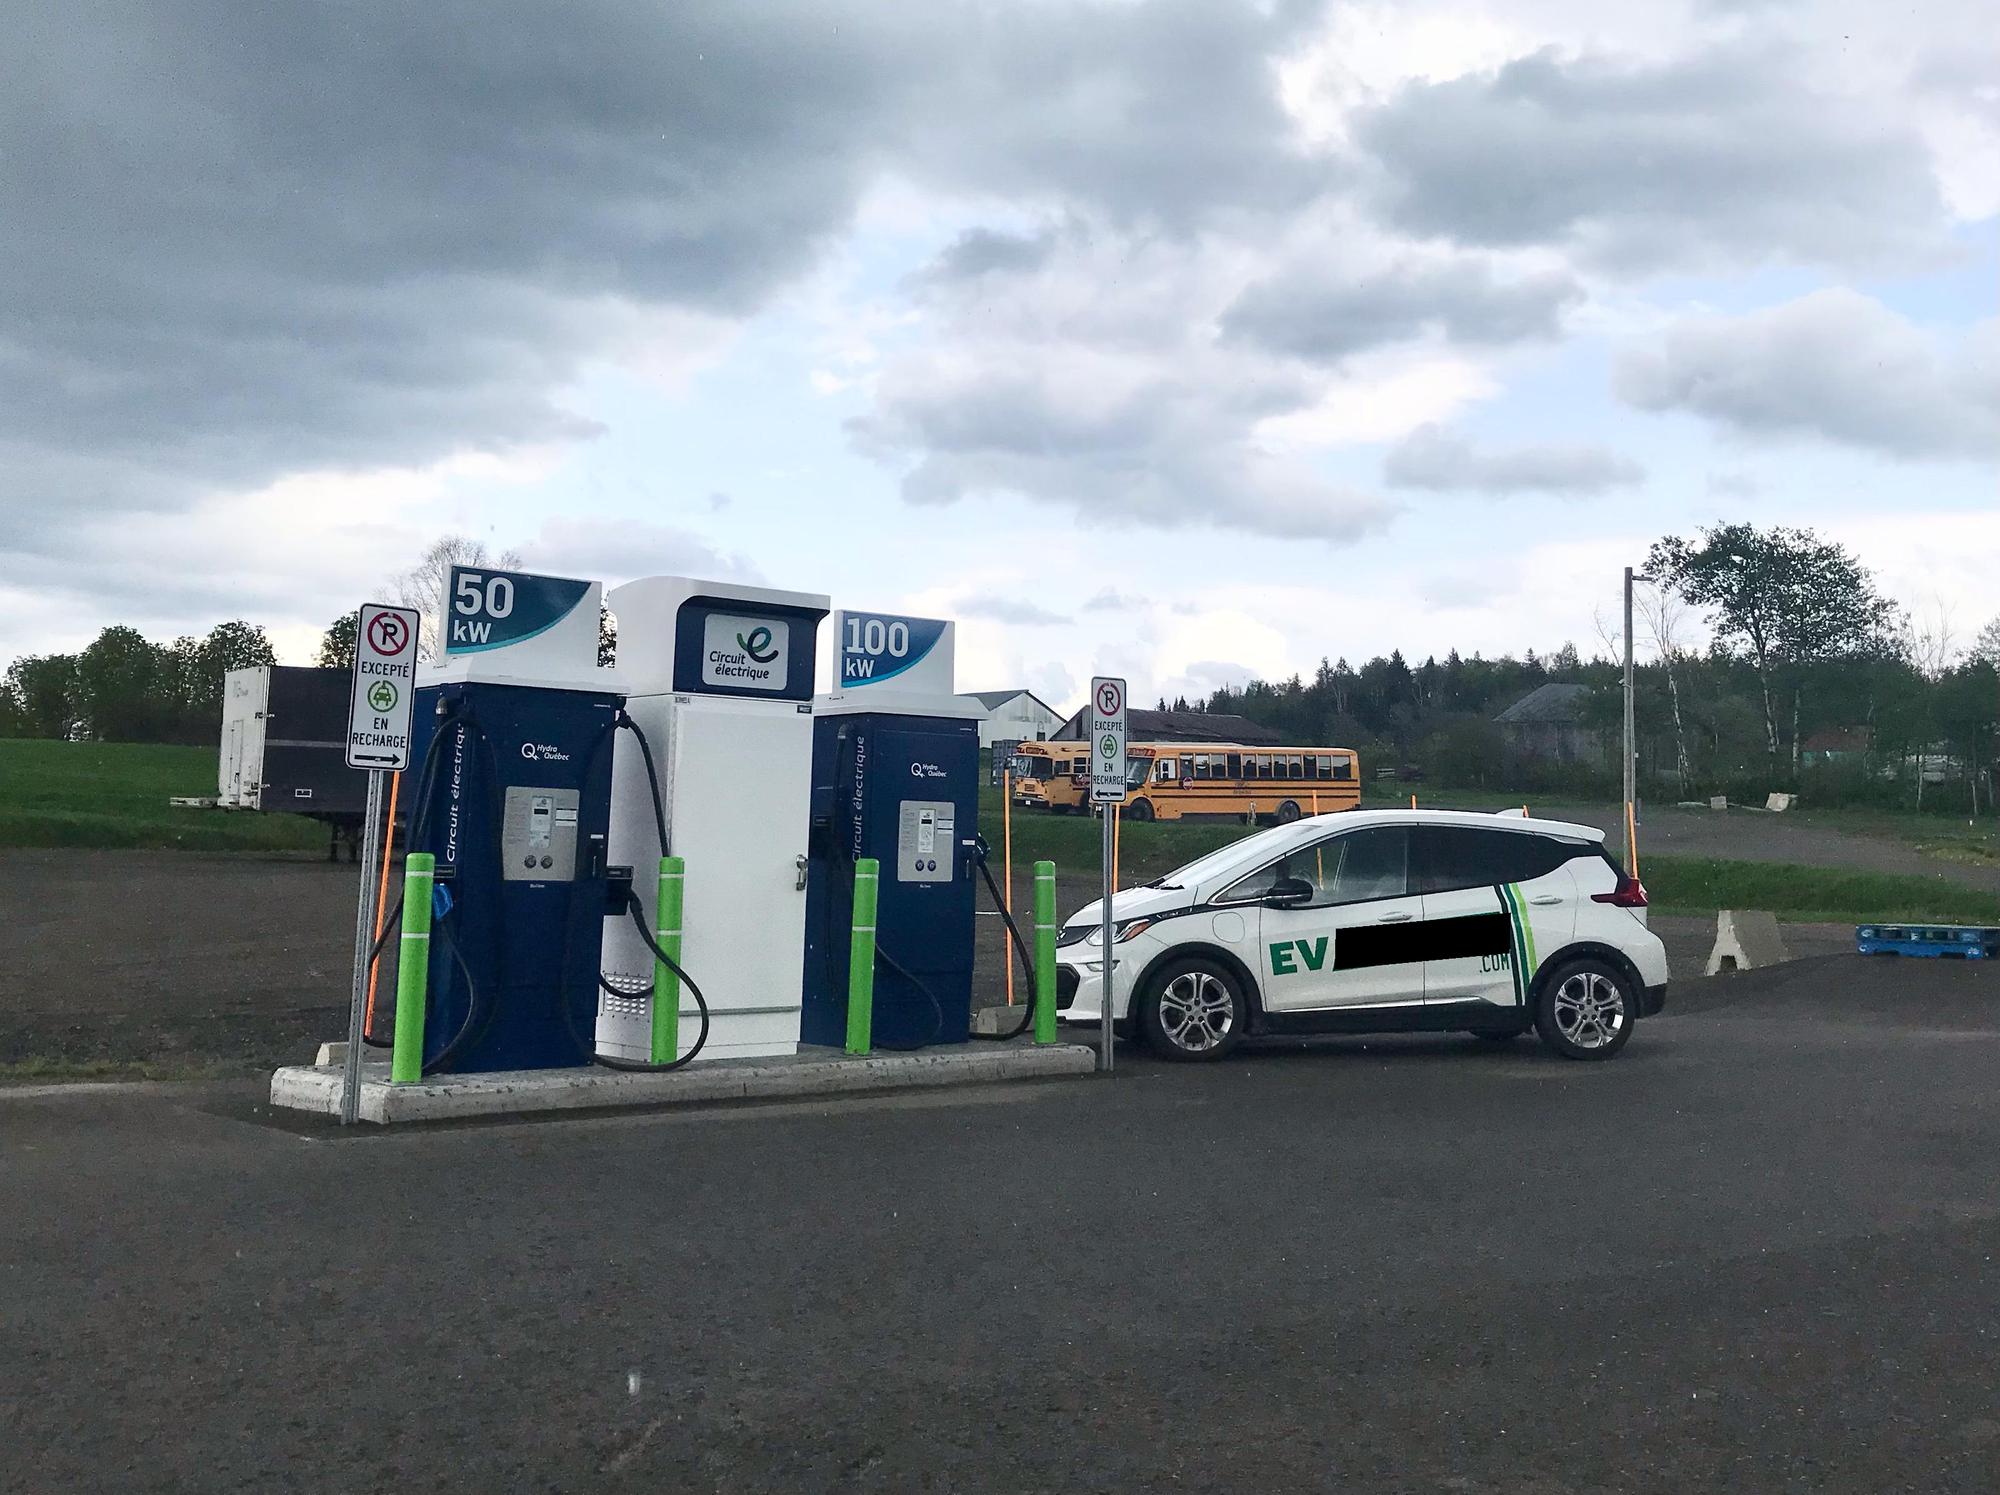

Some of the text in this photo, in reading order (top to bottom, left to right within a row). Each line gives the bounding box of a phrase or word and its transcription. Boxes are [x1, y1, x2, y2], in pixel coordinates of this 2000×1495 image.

[455, 572, 514, 619] 50
[453, 619, 492, 644] kW
[846, 617, 909, 658] 100
[709, 650, 746, 665] Circuit
[361, 661, 410, 678] EXCEPTÉ
[715, 663, 770, 681] électrique
[845, 657, 875, 678] kW
[373, 717, 389, 731] EN
[1094, 718, 1123, 732] EXCEPTÉ
[351, 732, 407, 749] RECHARGE
[536, 744, 558, 753] Hydro
[543, 752, 570, 761] Québec
[1104, 762, 1113, 773] EN
[1093, 775, 1125, 786] RECHARGE
[446, 722, 465, 863] Circuit électriqu
[852, 735, 867, 864] Circuit électrique
[1269, 936, 1329, 976] EV
